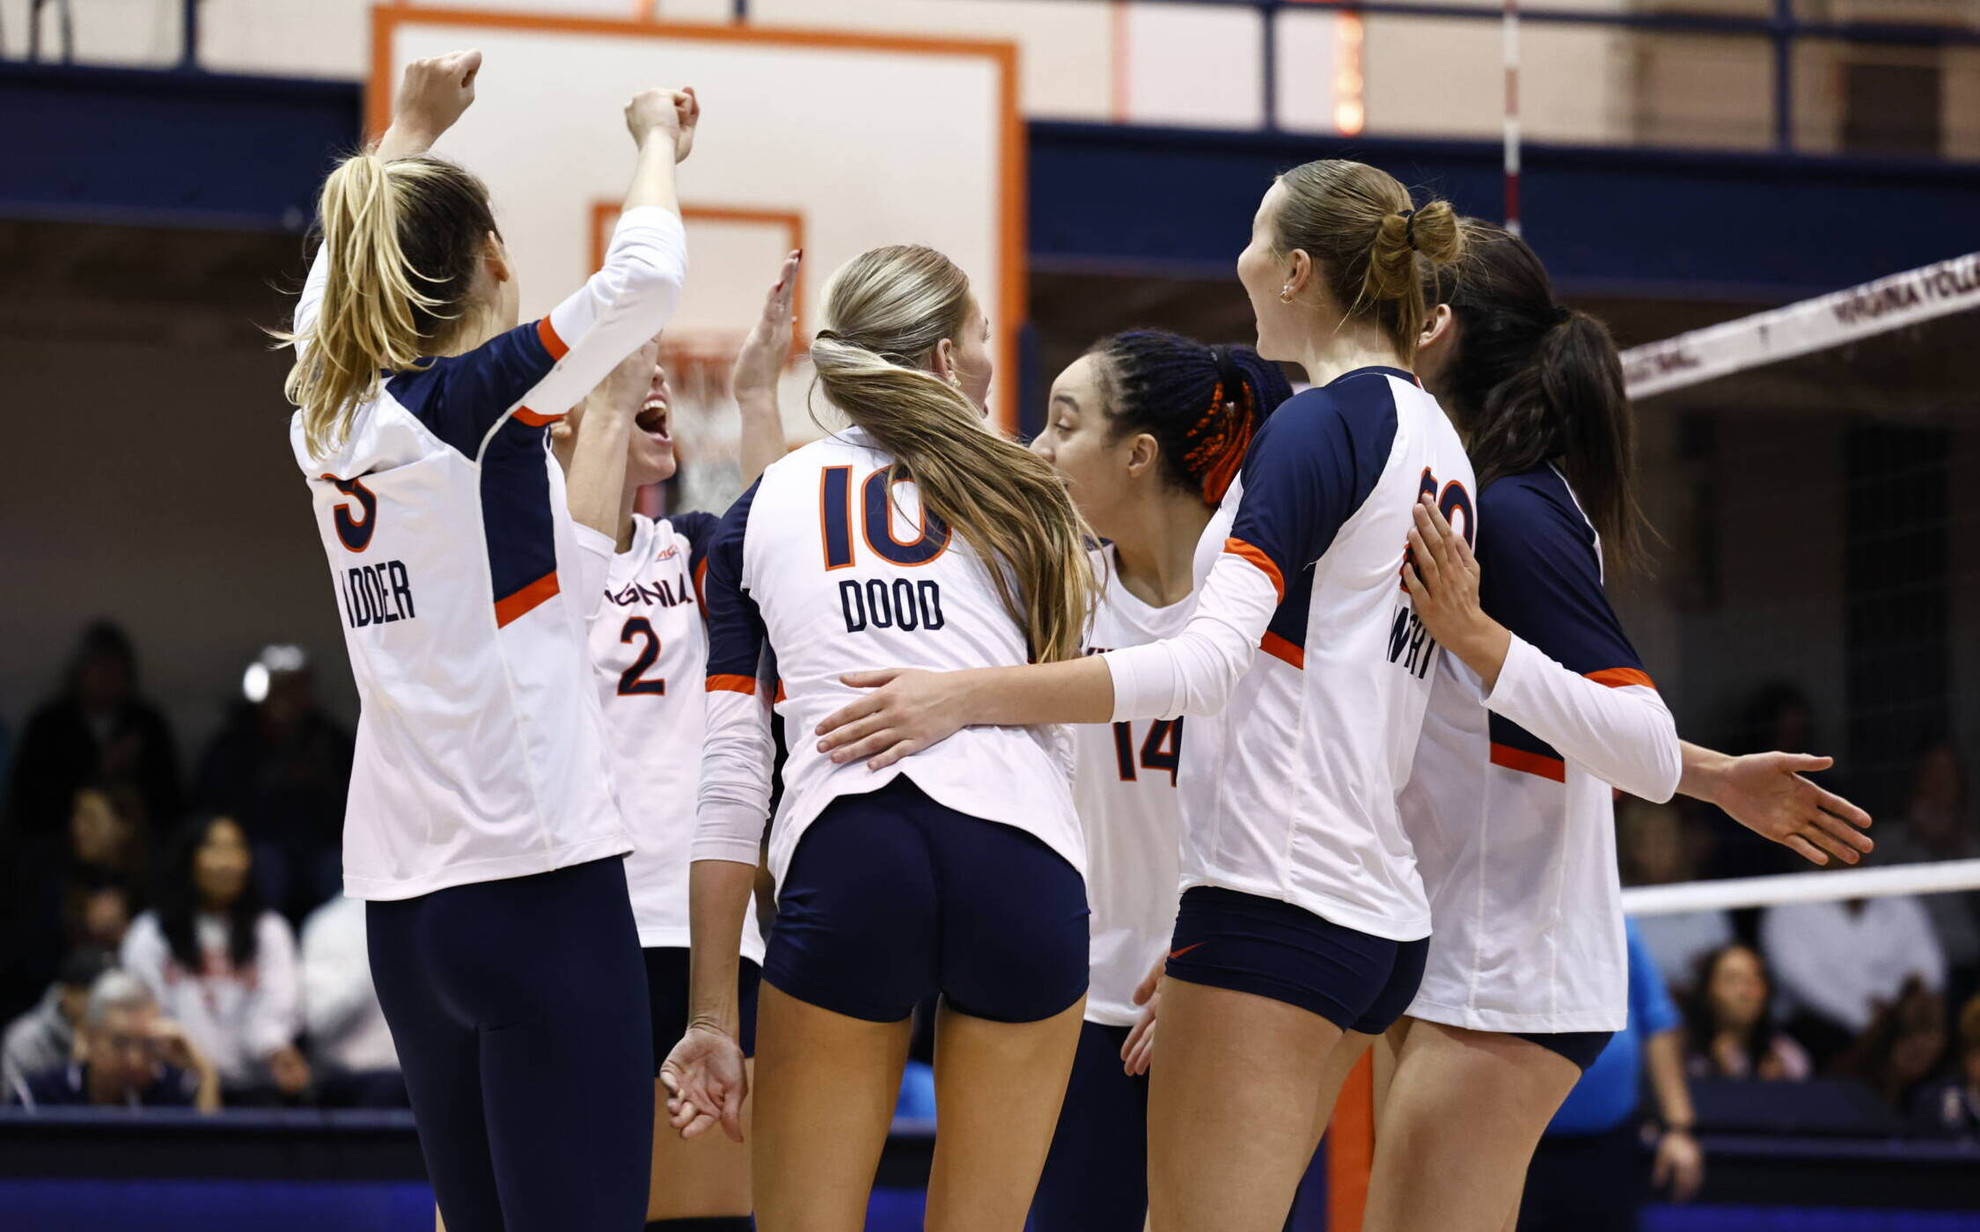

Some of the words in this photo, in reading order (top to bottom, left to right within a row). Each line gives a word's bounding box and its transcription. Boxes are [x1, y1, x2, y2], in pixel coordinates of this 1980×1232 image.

[320, 473, 377, 553] 3
[819, 464, 952, 571] 10
[839, 578, 944, 633] DOOD
[617, 616, 665, 696] 2
[1112, 715, 1184, 788] 14
